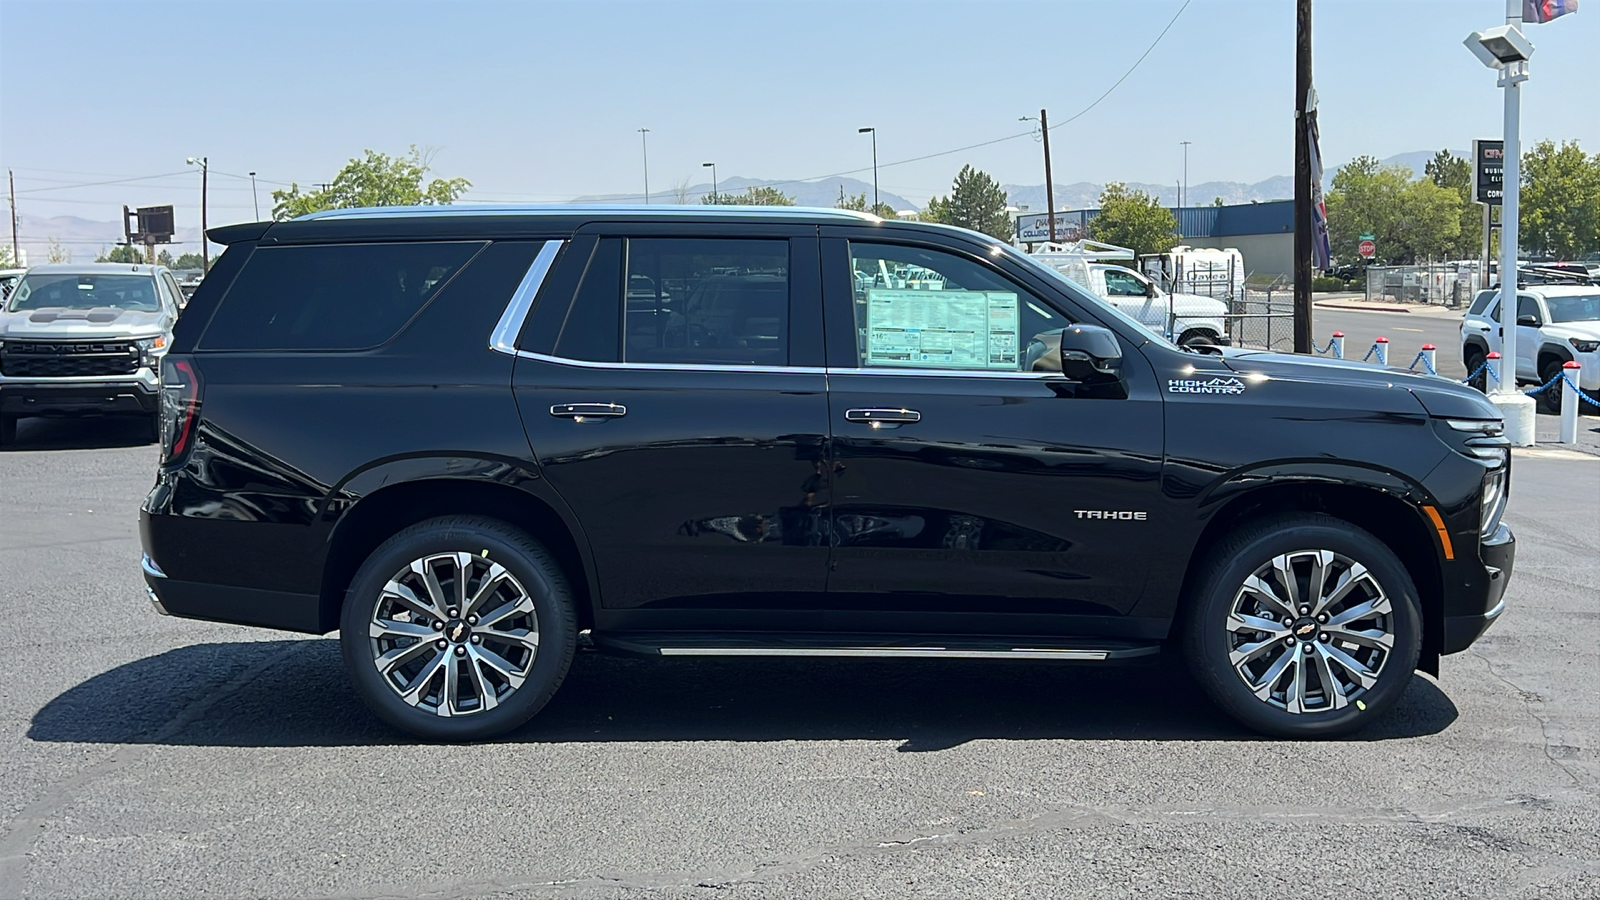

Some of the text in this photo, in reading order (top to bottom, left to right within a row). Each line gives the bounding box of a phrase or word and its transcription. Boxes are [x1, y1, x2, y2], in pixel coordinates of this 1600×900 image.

[1484, 149, 1503, 158] GM
[12, 343, 128, 352] CHEVROLET
[1168, 379, 1207, 387] HIGH
[1168, 386, 1245, 395] COUNTRY
[1073, 510, 1147, 520] TAHOE
